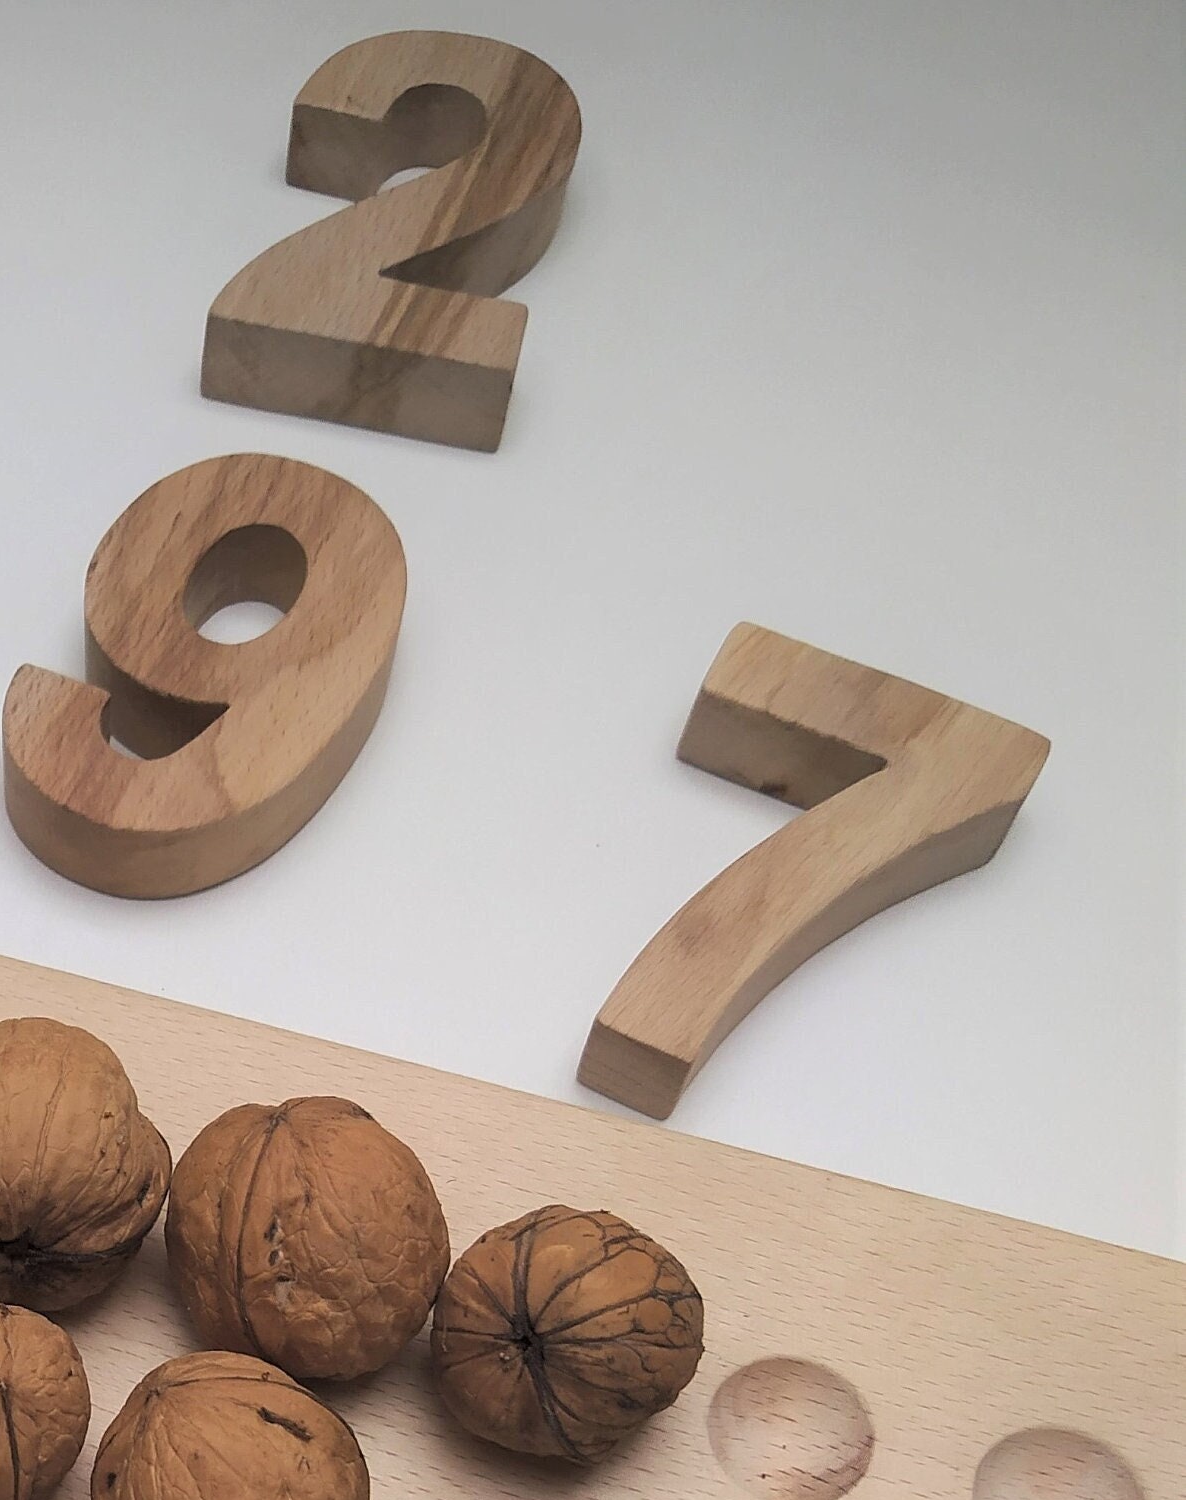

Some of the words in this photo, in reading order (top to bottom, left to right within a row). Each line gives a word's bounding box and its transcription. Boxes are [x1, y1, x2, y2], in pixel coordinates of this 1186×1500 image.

[201, 30, 582, 454] 2
[3, 453, 407, 901] 9
[577, 621, 1051, 1120] 7
